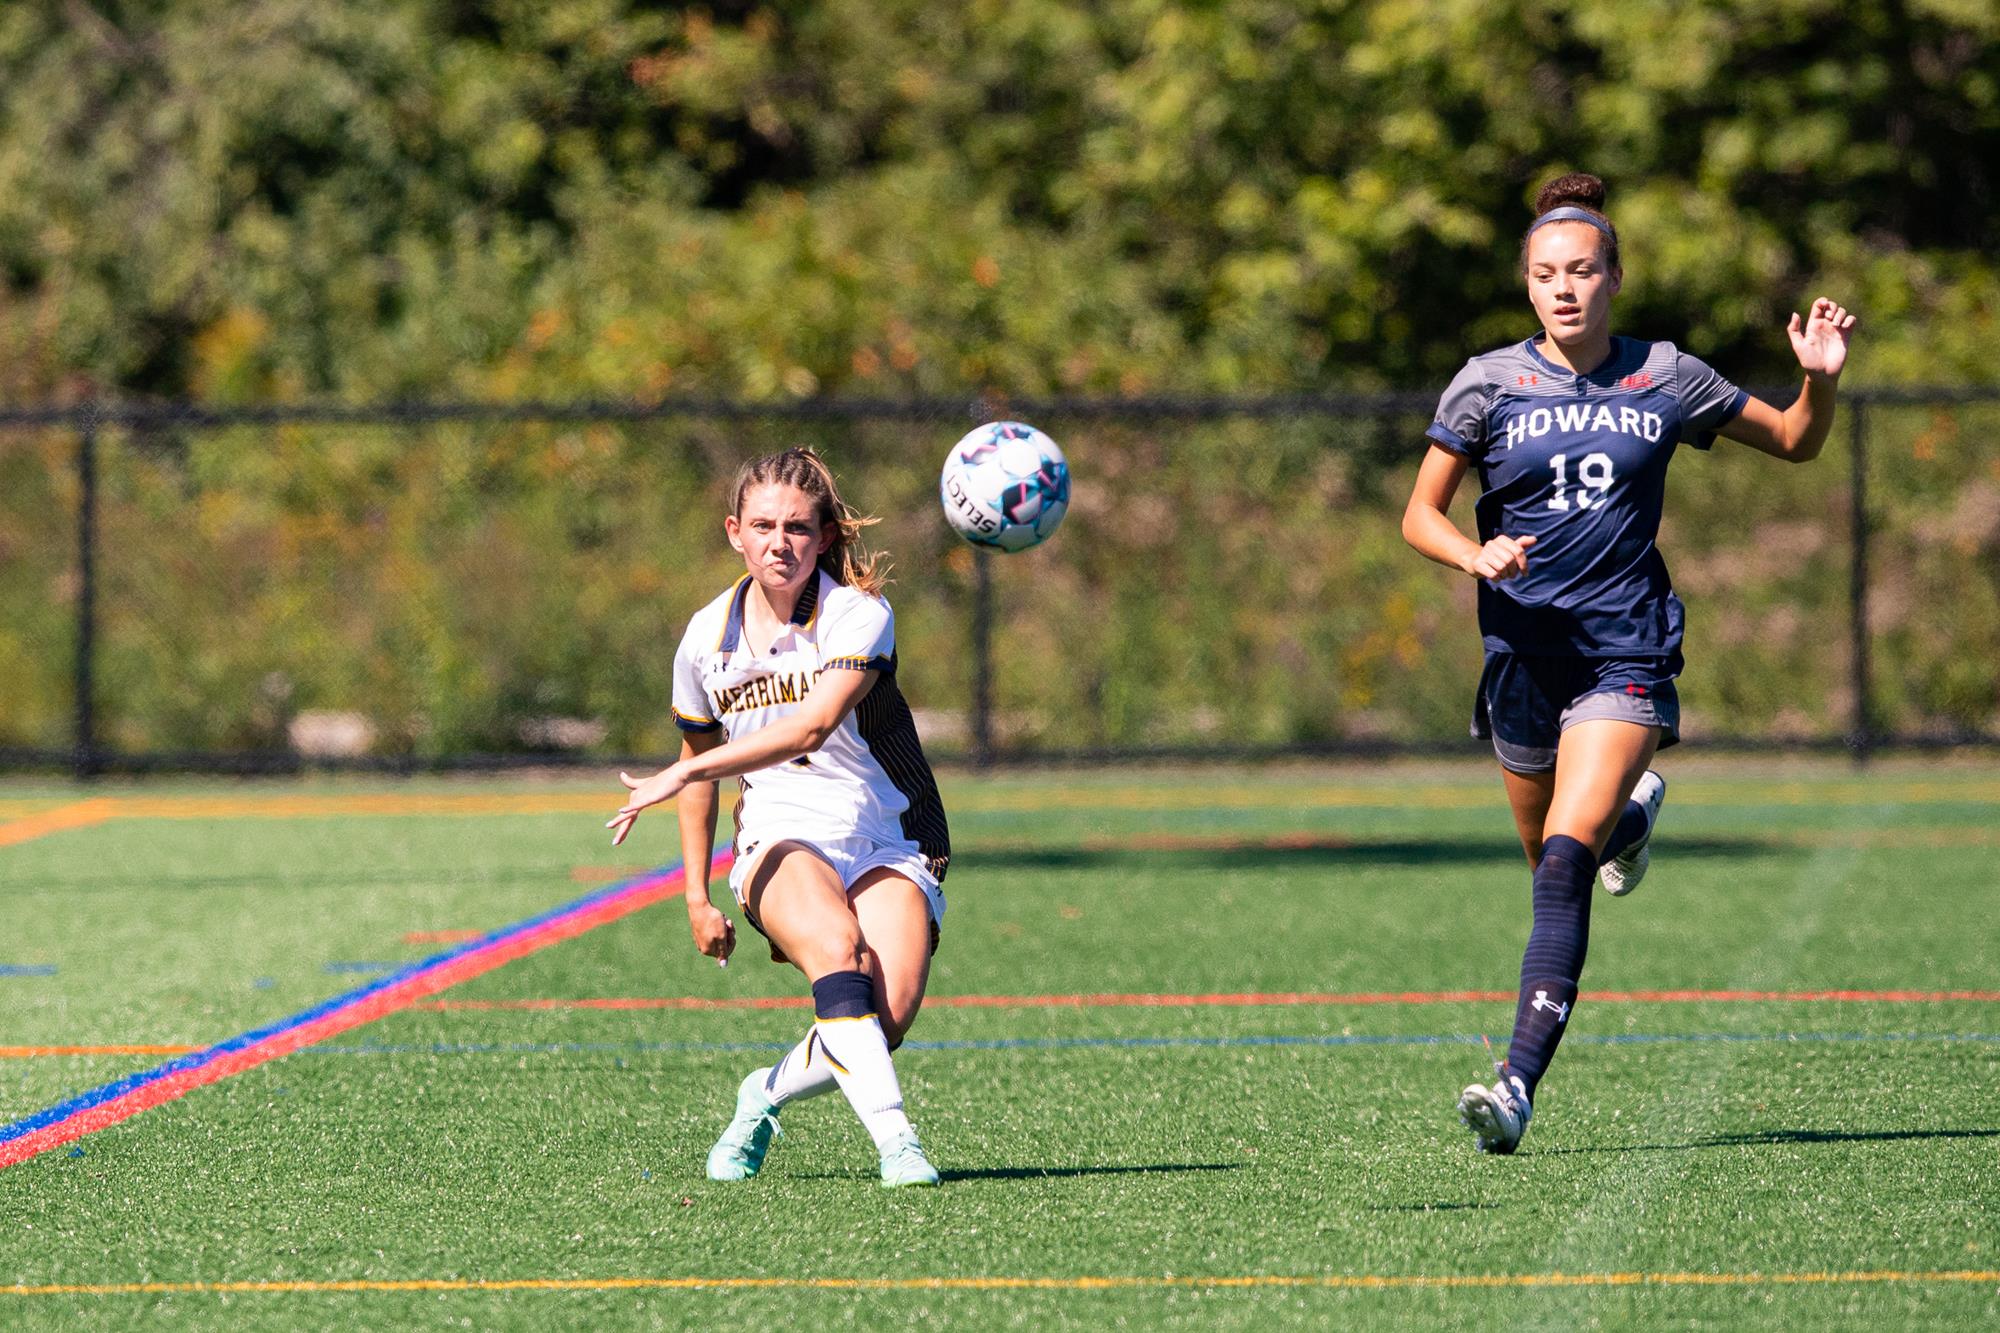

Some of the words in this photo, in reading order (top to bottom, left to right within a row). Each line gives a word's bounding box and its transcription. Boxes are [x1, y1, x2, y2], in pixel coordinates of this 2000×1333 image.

[1507, 404, 1662, 449] HOWARD
[947, 474, 997, 533] SELECT
[1548, 453, 1614, 511] 19
